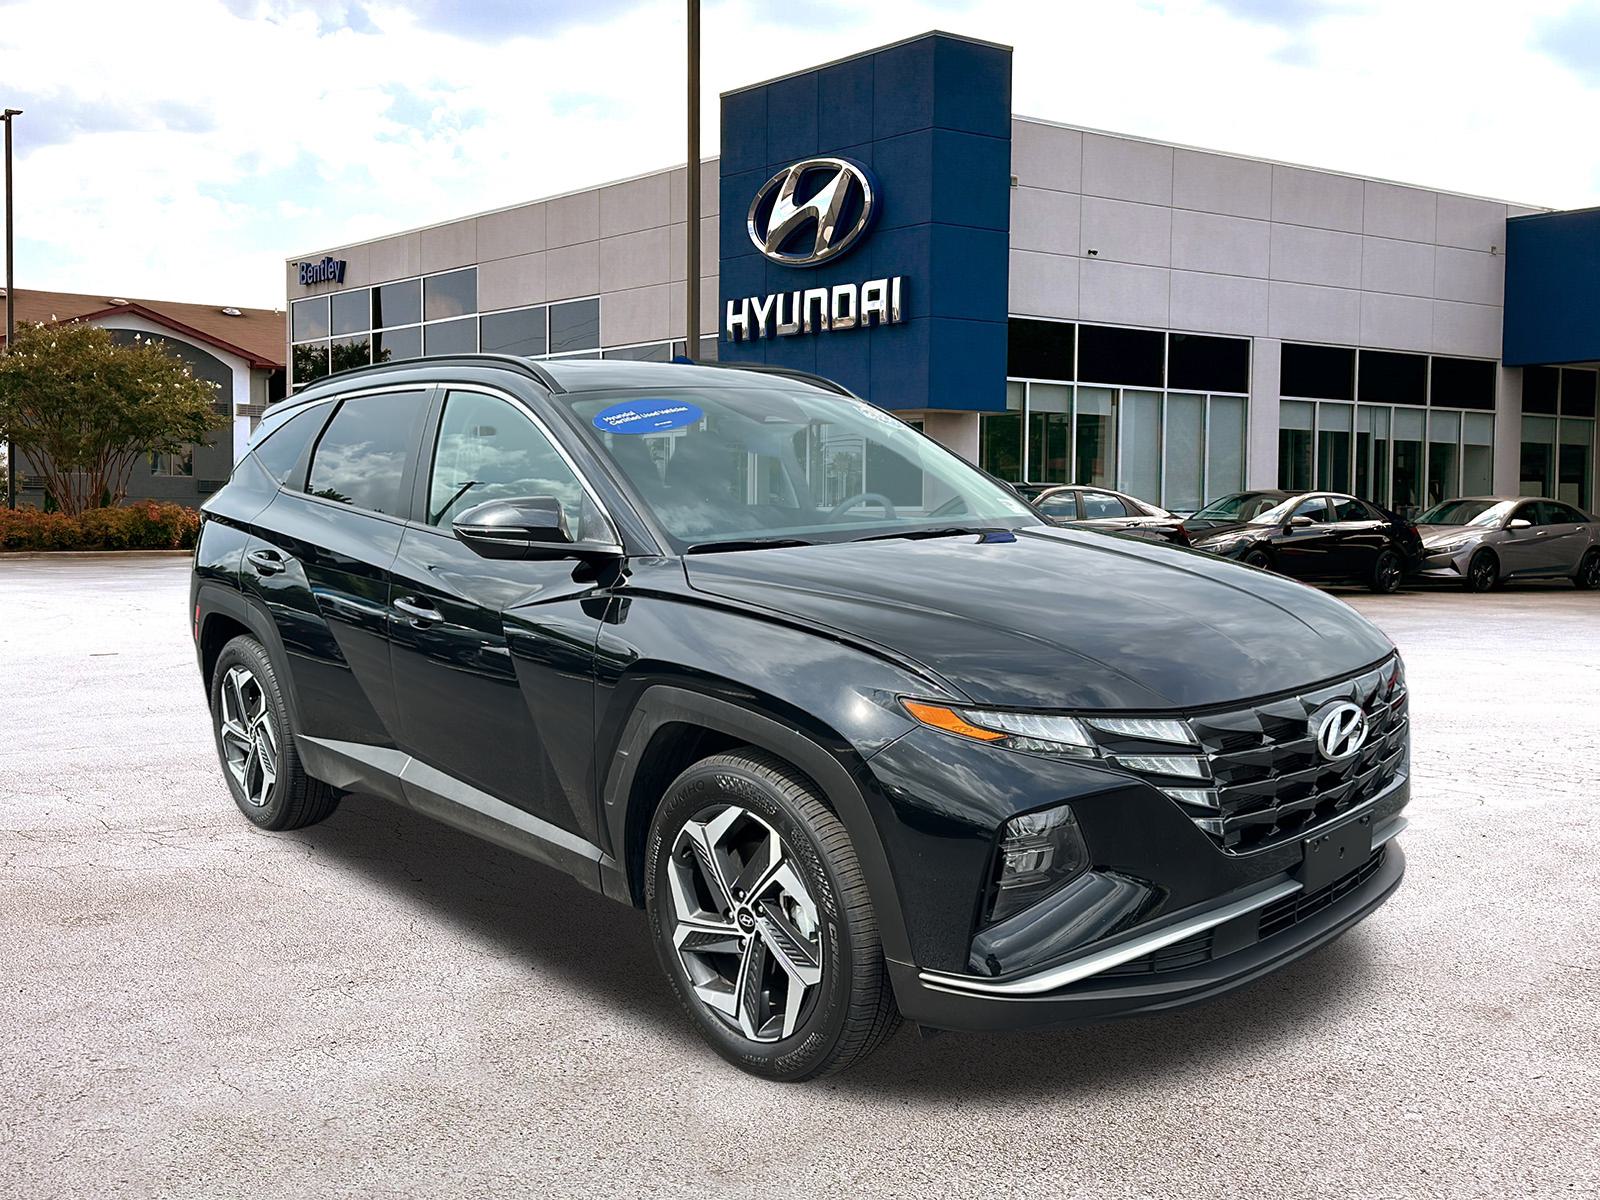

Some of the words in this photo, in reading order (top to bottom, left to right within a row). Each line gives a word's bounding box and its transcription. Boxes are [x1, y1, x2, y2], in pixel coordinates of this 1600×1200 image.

[299, 257, 345, 284] Bentley
[726, 276, 903, 343] HYUNDAI
[602, 410, 636, 422] Hyundai
[609, 415, 641, 426] Certified
[663, 780, 705, 819] KUMHO
